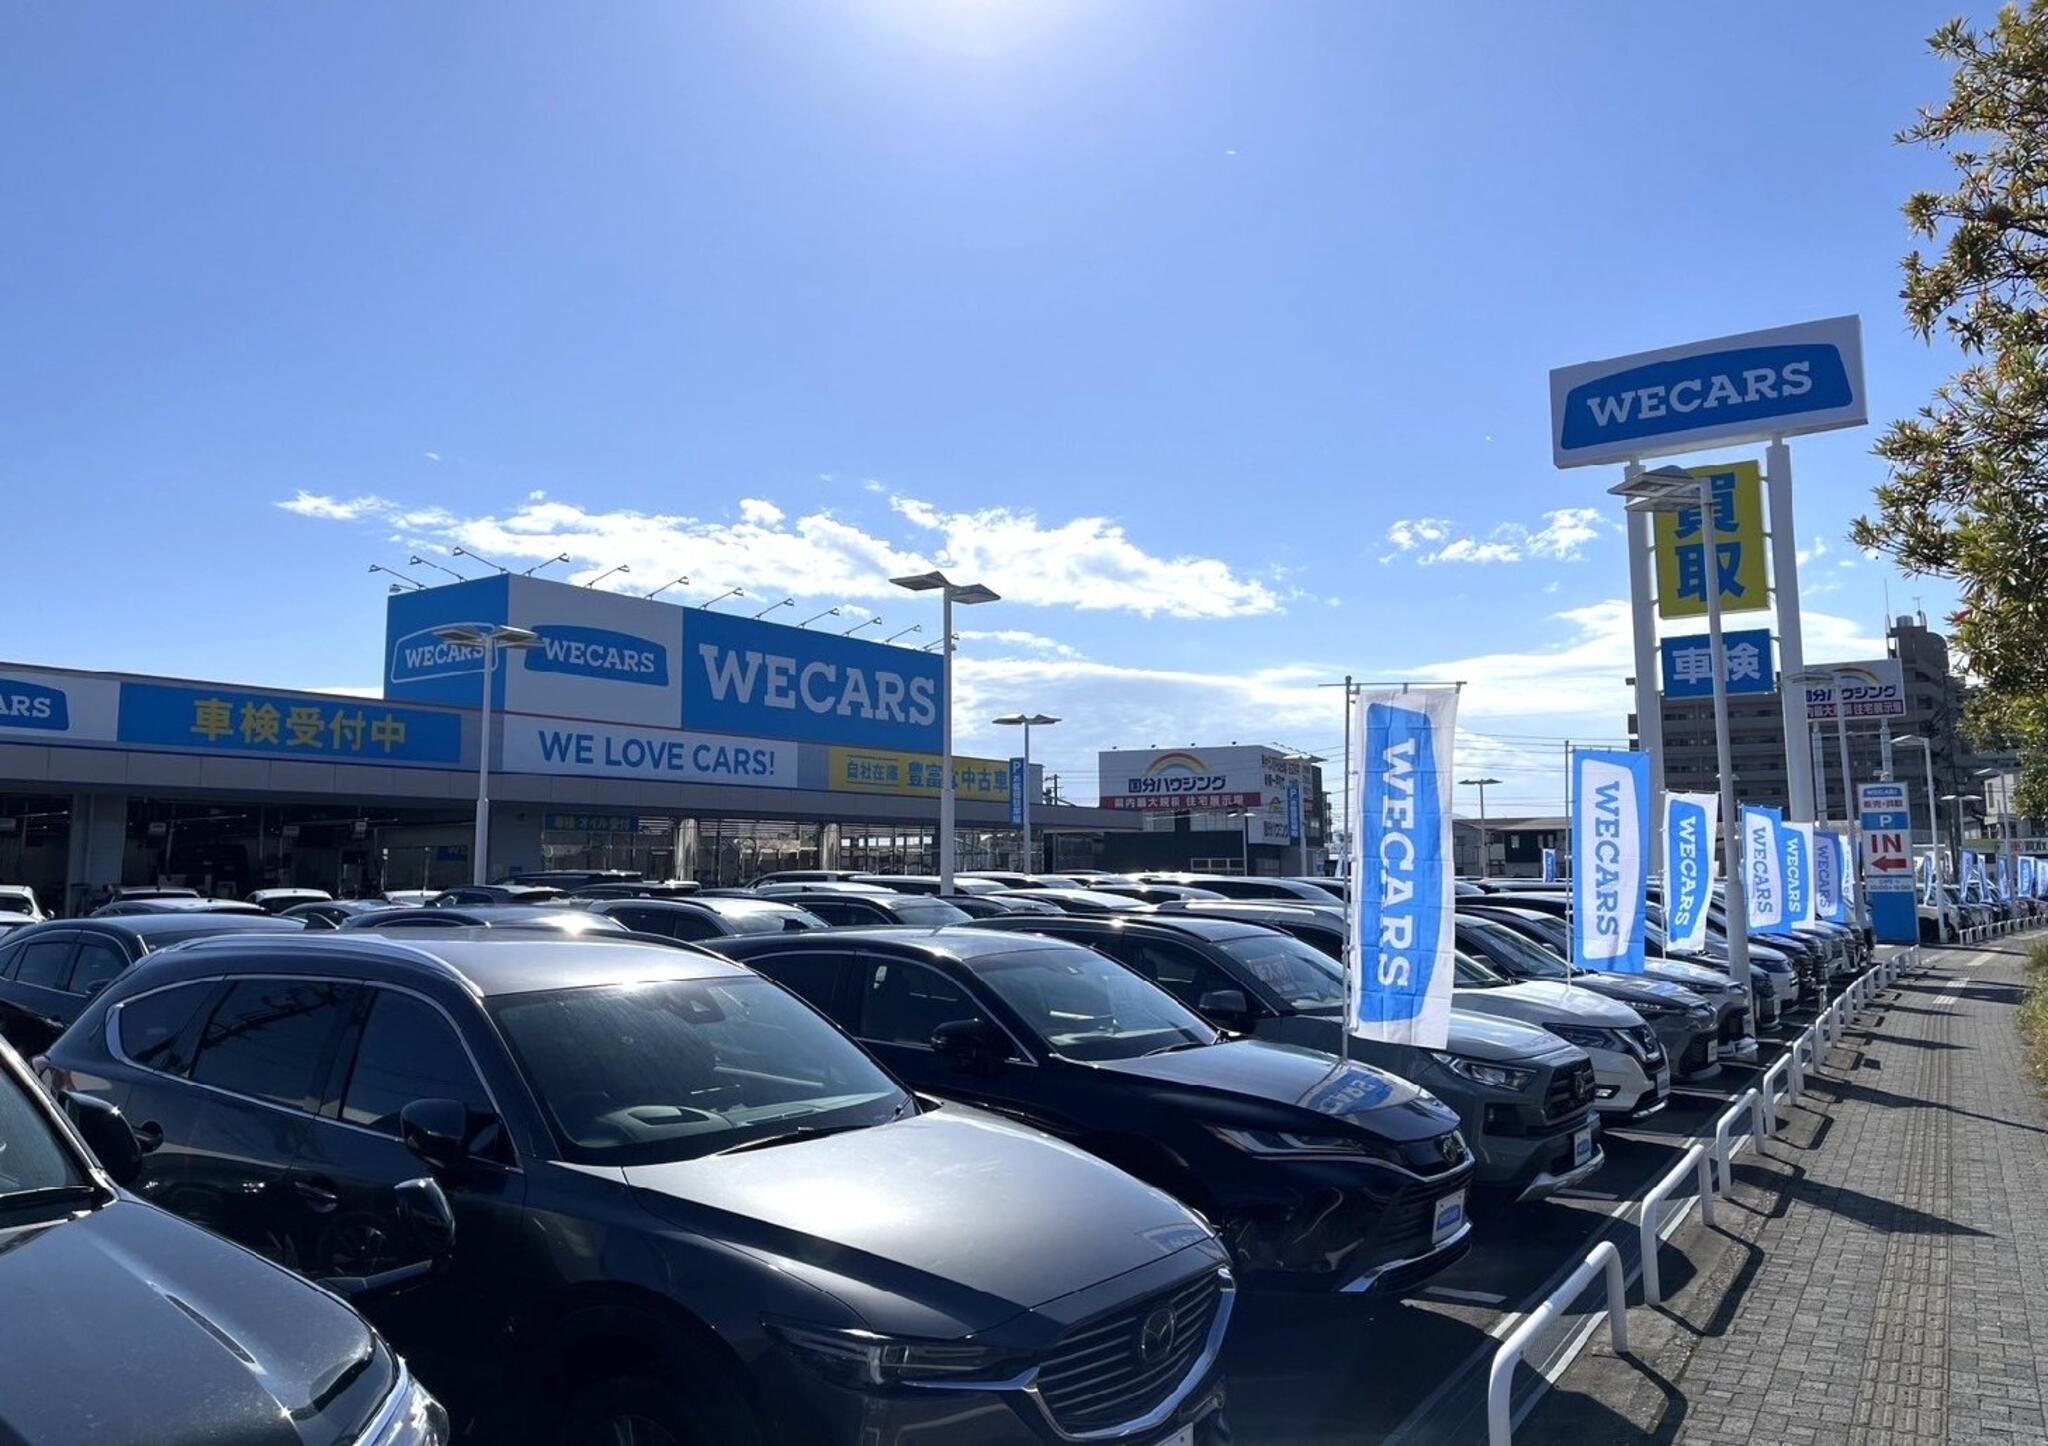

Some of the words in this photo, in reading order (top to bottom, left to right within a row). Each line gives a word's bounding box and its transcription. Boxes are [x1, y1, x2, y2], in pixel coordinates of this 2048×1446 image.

[1587, 361, 1812, 426] WECARS
[1674, 472, 1747, 602] 買取
[405, 641, 484, 668] WECARS
[543, 637, 654, 673] WECARS
[699, 643, 936, 726] WECARS
[1673, 643, 1761, 684] 車検
[190, 697, 407, 754] 車検受付中
[538, 730, 594, 763] WE
[605, 737, 684, 771] LOVE
[693, 744, 775, 775] CARS!
[1129, 776, 1226, 793] 国分ハウジング
[1871, 834, 1902, 853] IN
[1880, 815, 1893, 827] P
[1377, 738, 1416, 988] WECARS
[1595, 781, 1620, 936] WECARS
[1675, 816, 1696, 926] WECARS
[1752, 827, 1773, 913] WECARS
[1786, 838, 1801, 913] WECARS
[1817, 844, 1831, 909] WECARS
